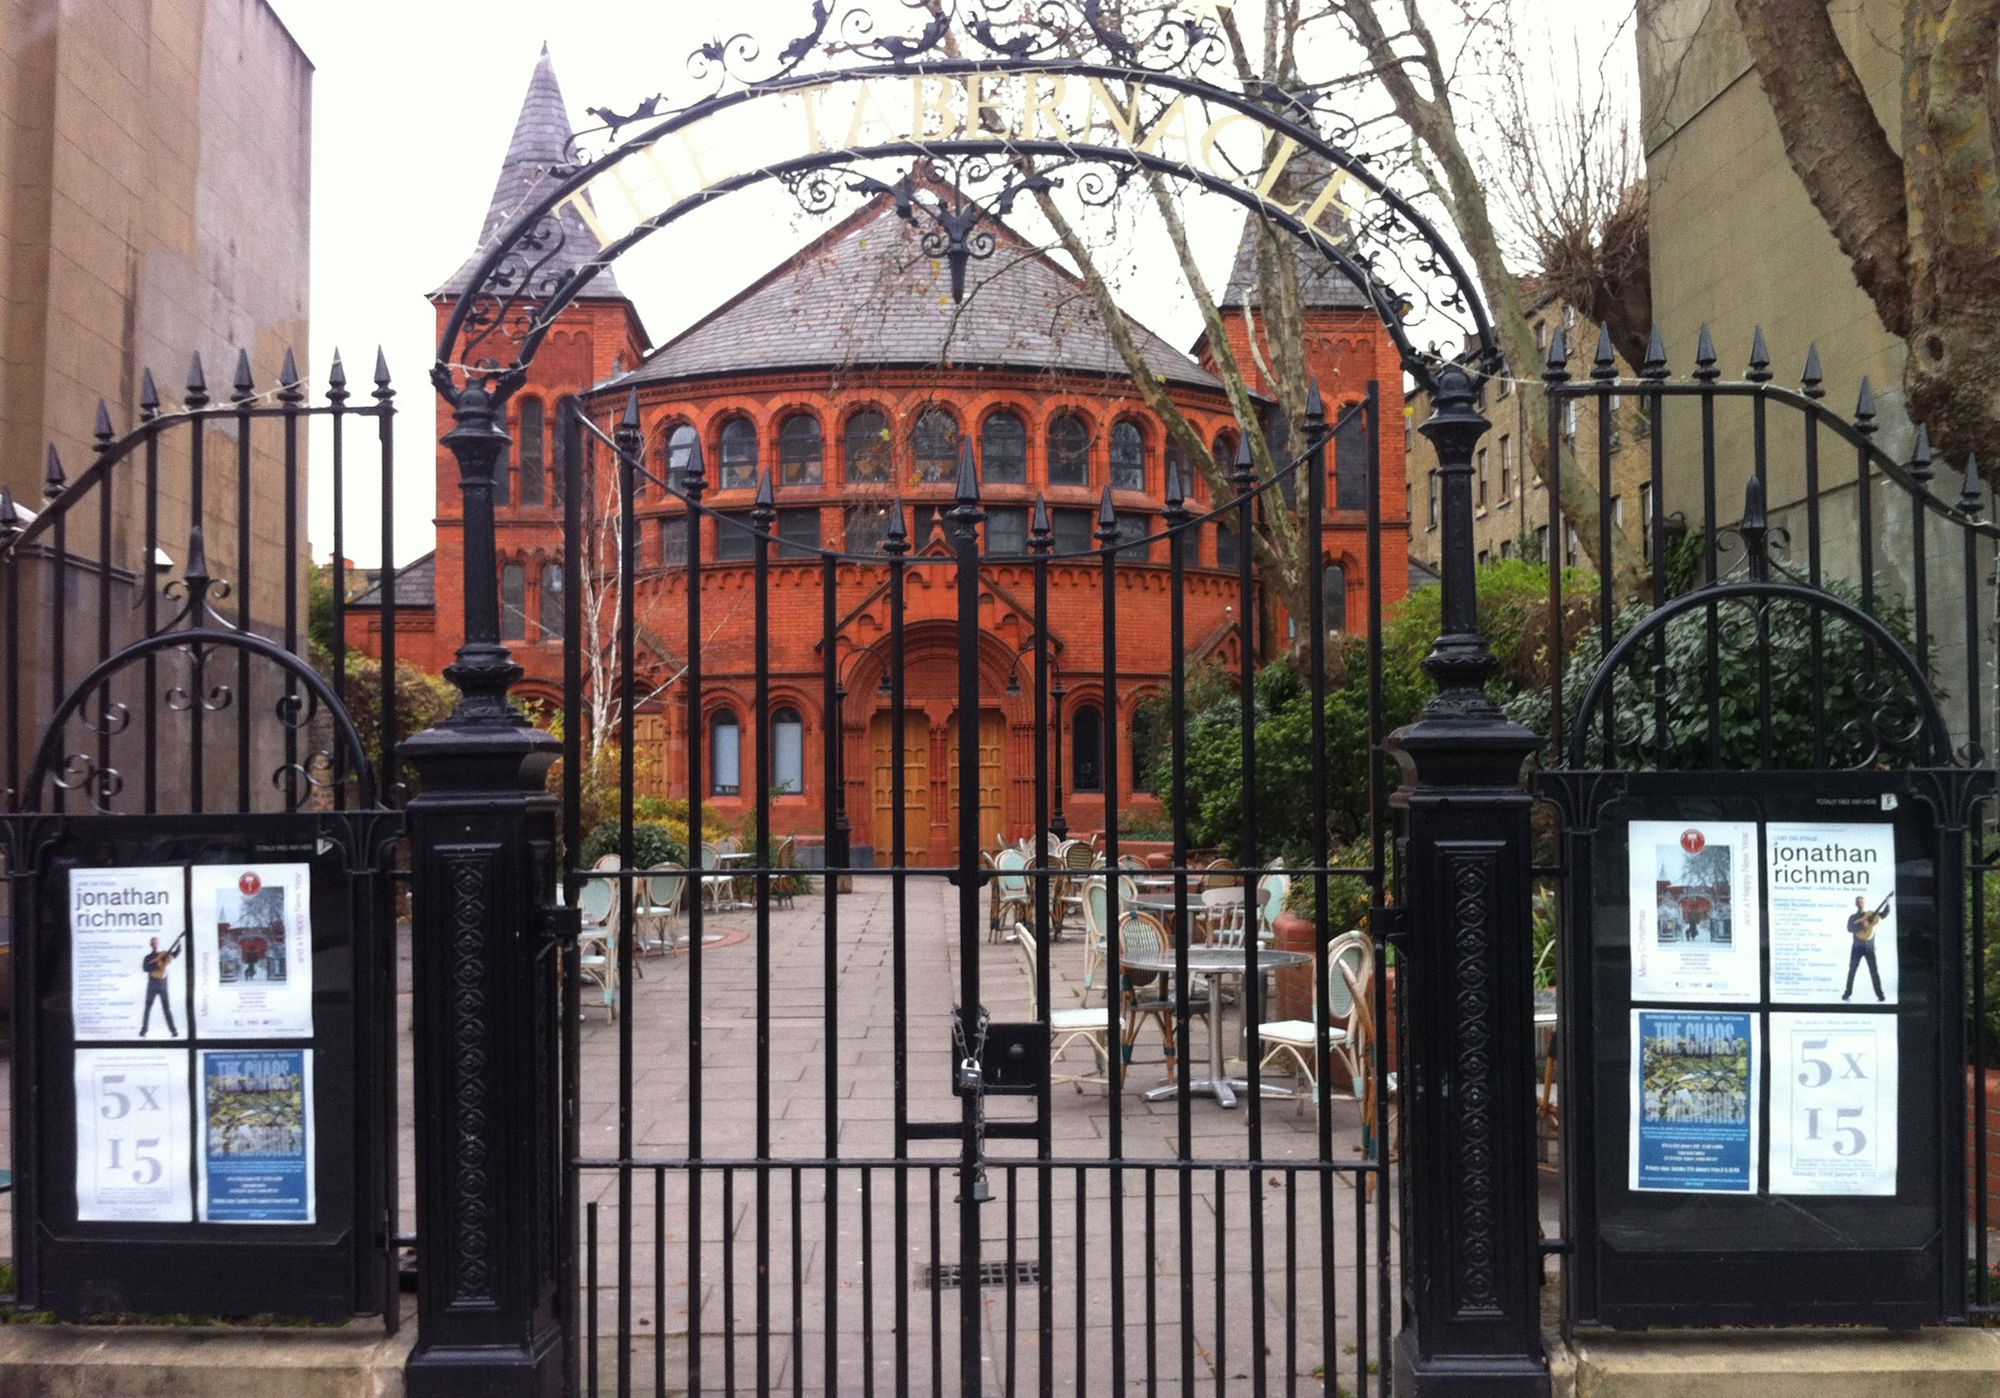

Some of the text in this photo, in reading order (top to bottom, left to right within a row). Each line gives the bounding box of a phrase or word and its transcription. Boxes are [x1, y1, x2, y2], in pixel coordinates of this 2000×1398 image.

[778, 72, 1366, 244] TABERNACLE
[1772, 842, 1877, 866] jonathan
[1774, 864, 1870, 885] richman
[76, 888, 169, 910] jonathan
[76, 909, 163, 928] richman
[1653, 1022, 1738, 1056] THE CHAOS
